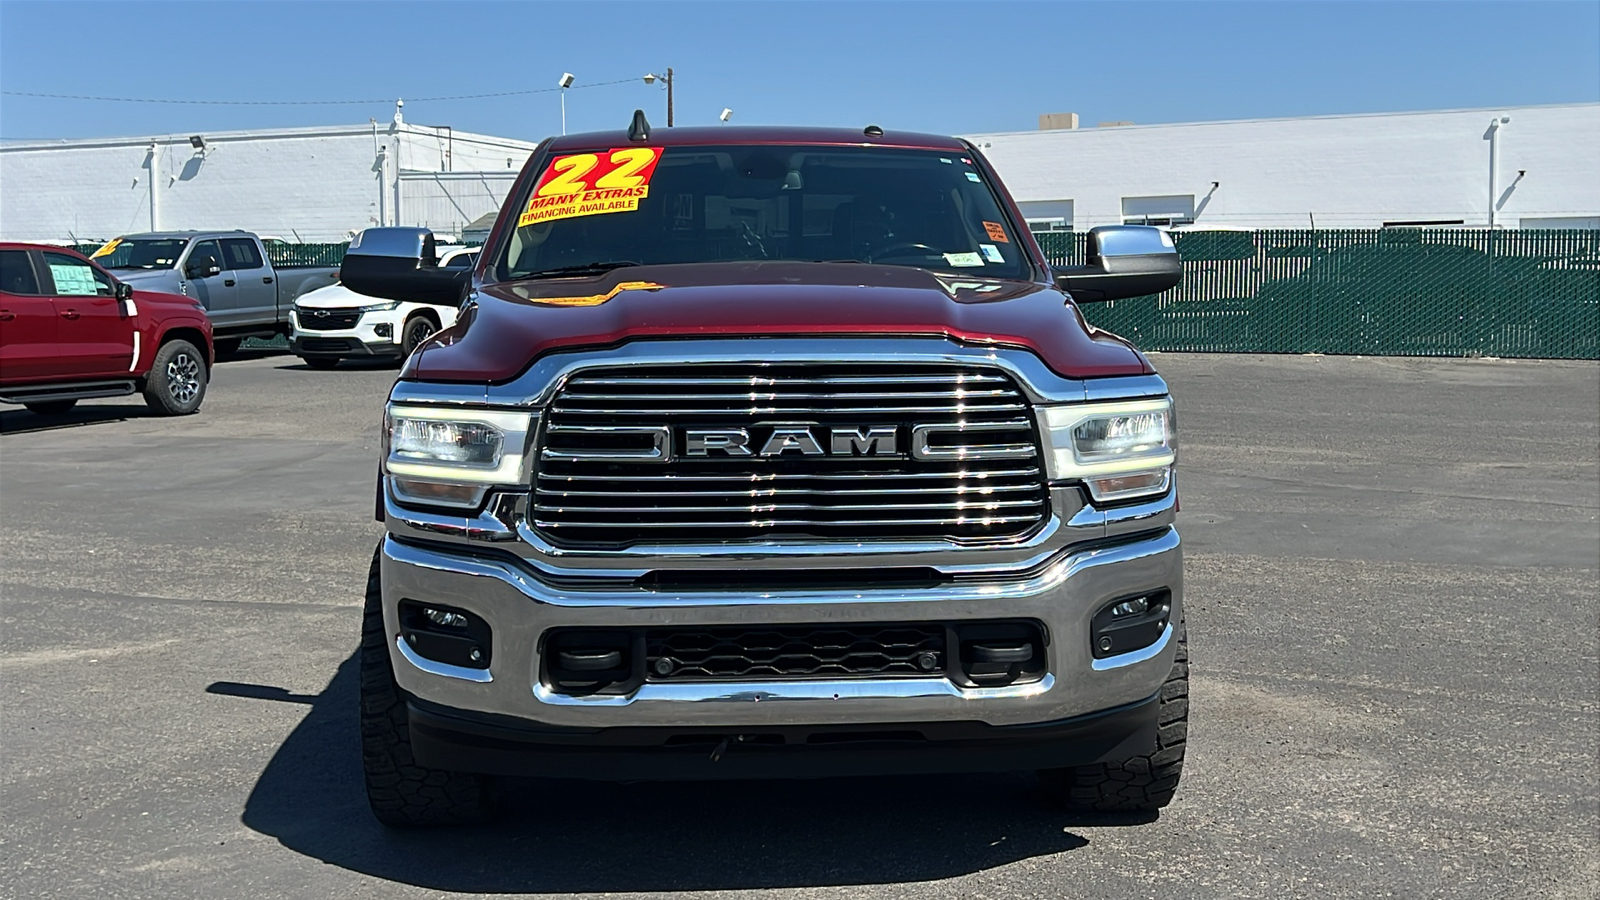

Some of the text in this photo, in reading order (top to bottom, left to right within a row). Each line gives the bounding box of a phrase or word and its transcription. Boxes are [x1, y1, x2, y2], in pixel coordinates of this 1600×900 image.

[538, 148, 656, 196] 22
[522, 200, 634, 223] FINANCING AVAILABLE
[530, 187, 645, 210] MANY EXTRAS
[686, 425, 898, 456] RAM
